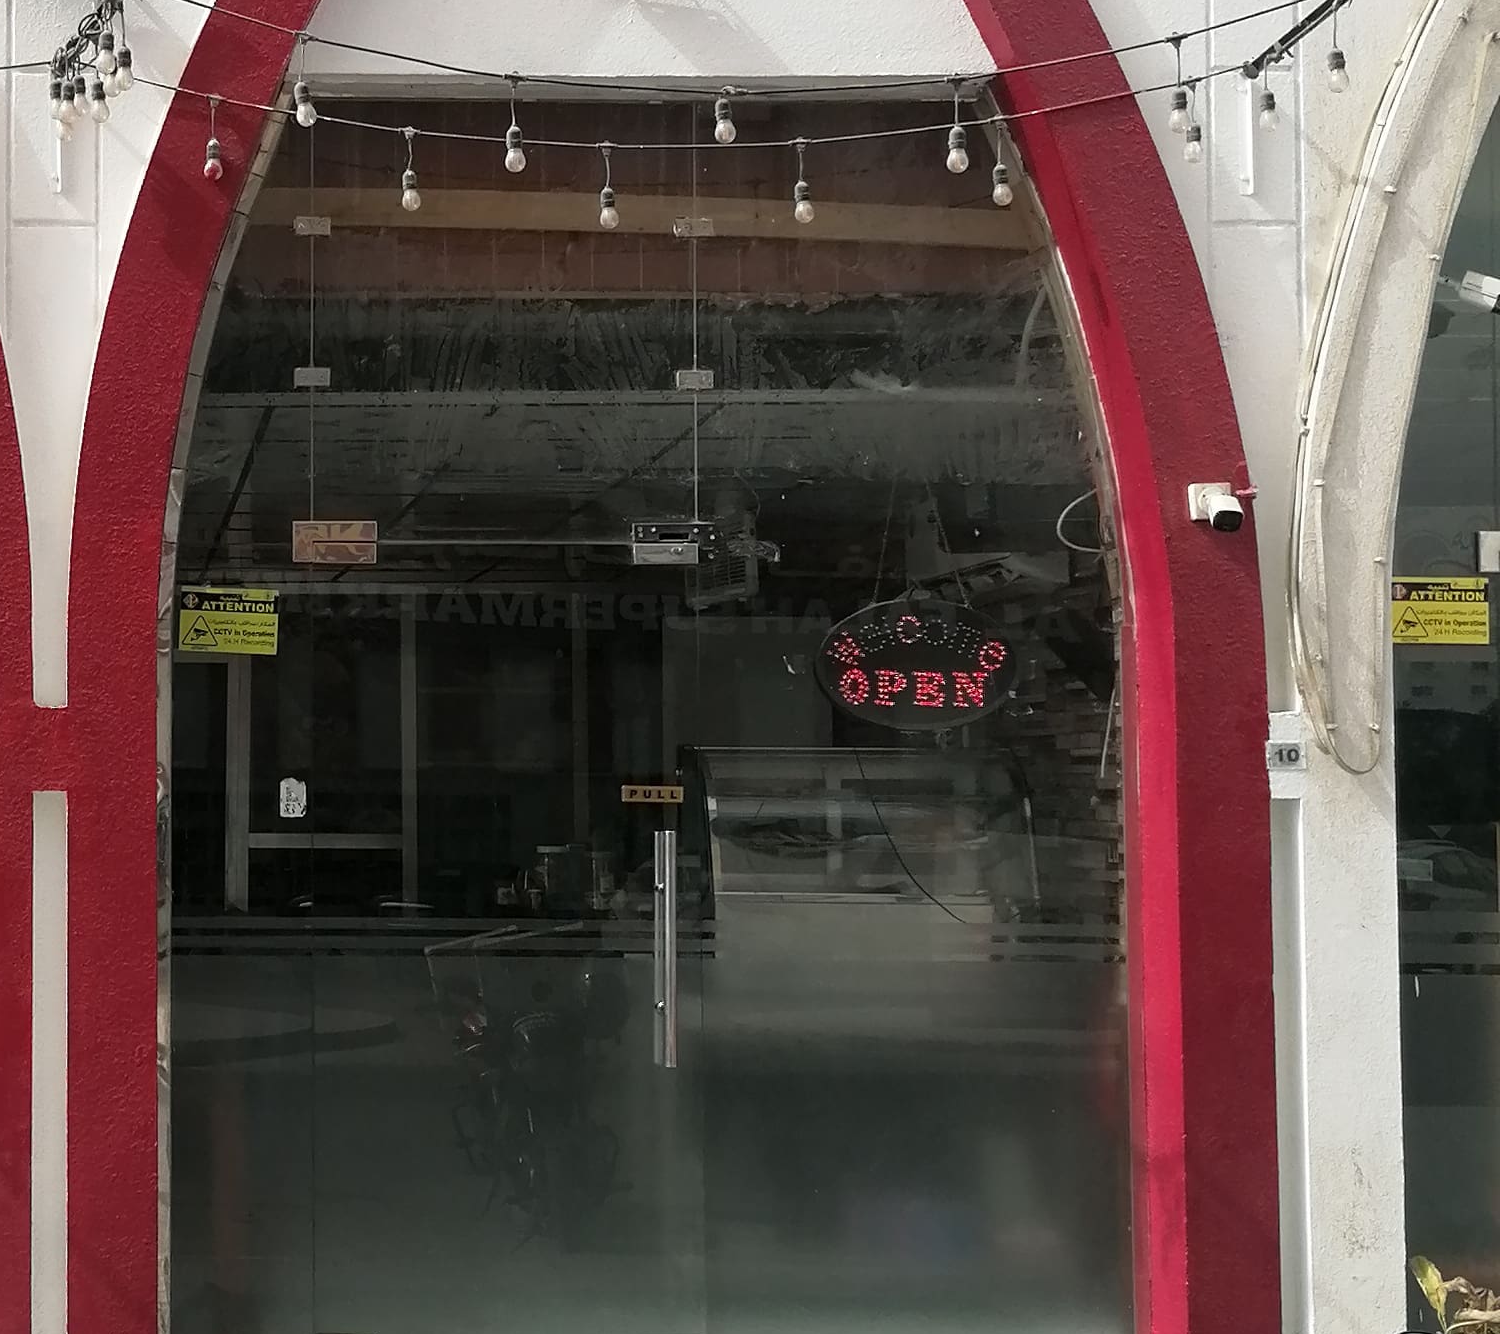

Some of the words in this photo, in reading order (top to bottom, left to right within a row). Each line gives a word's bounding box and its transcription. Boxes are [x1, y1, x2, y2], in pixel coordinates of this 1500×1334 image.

[1410, 590, 1485, 602] ATTENTION
[202, 600, 275, 613] ATTENTION
[1452, 619, 1487, 627] Operation
[838, 668, 989, 709] OPEN
[1274, 748, 1300, 763] 10
[629, 789, 678, 800] PULL
